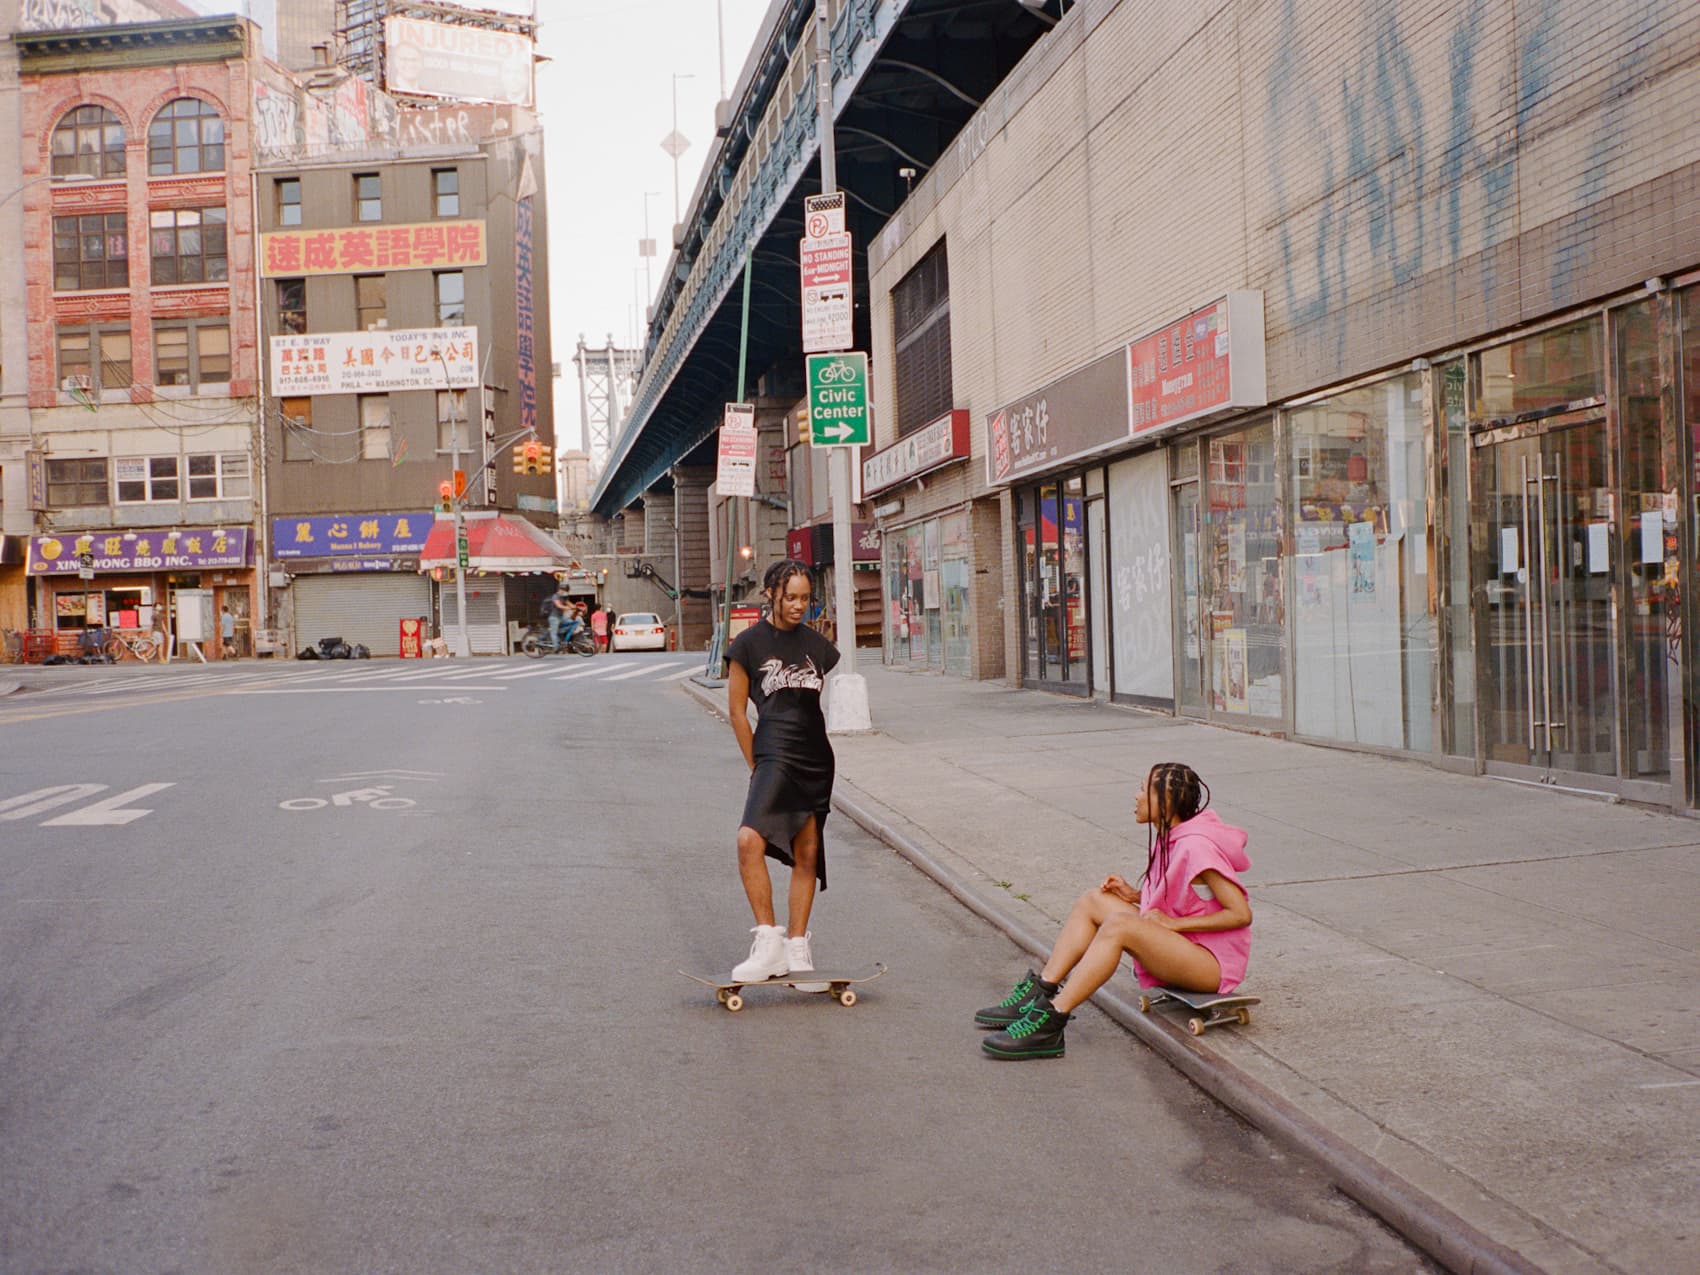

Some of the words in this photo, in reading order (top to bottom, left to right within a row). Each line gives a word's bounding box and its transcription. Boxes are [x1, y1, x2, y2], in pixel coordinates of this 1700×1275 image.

[267, 224, 481, 272] 速成英語學院
[803, 254, 813, 264] NO
[815, 248, 849, 262] STANDING
[390, 331, 428, 341] TODAY'S
[818, 388, 856, 403] Civic
[813, 405, 864, 419] Center
[133, 556, 162, 568] BBQ
[165, 555, 193, 566] INC.
